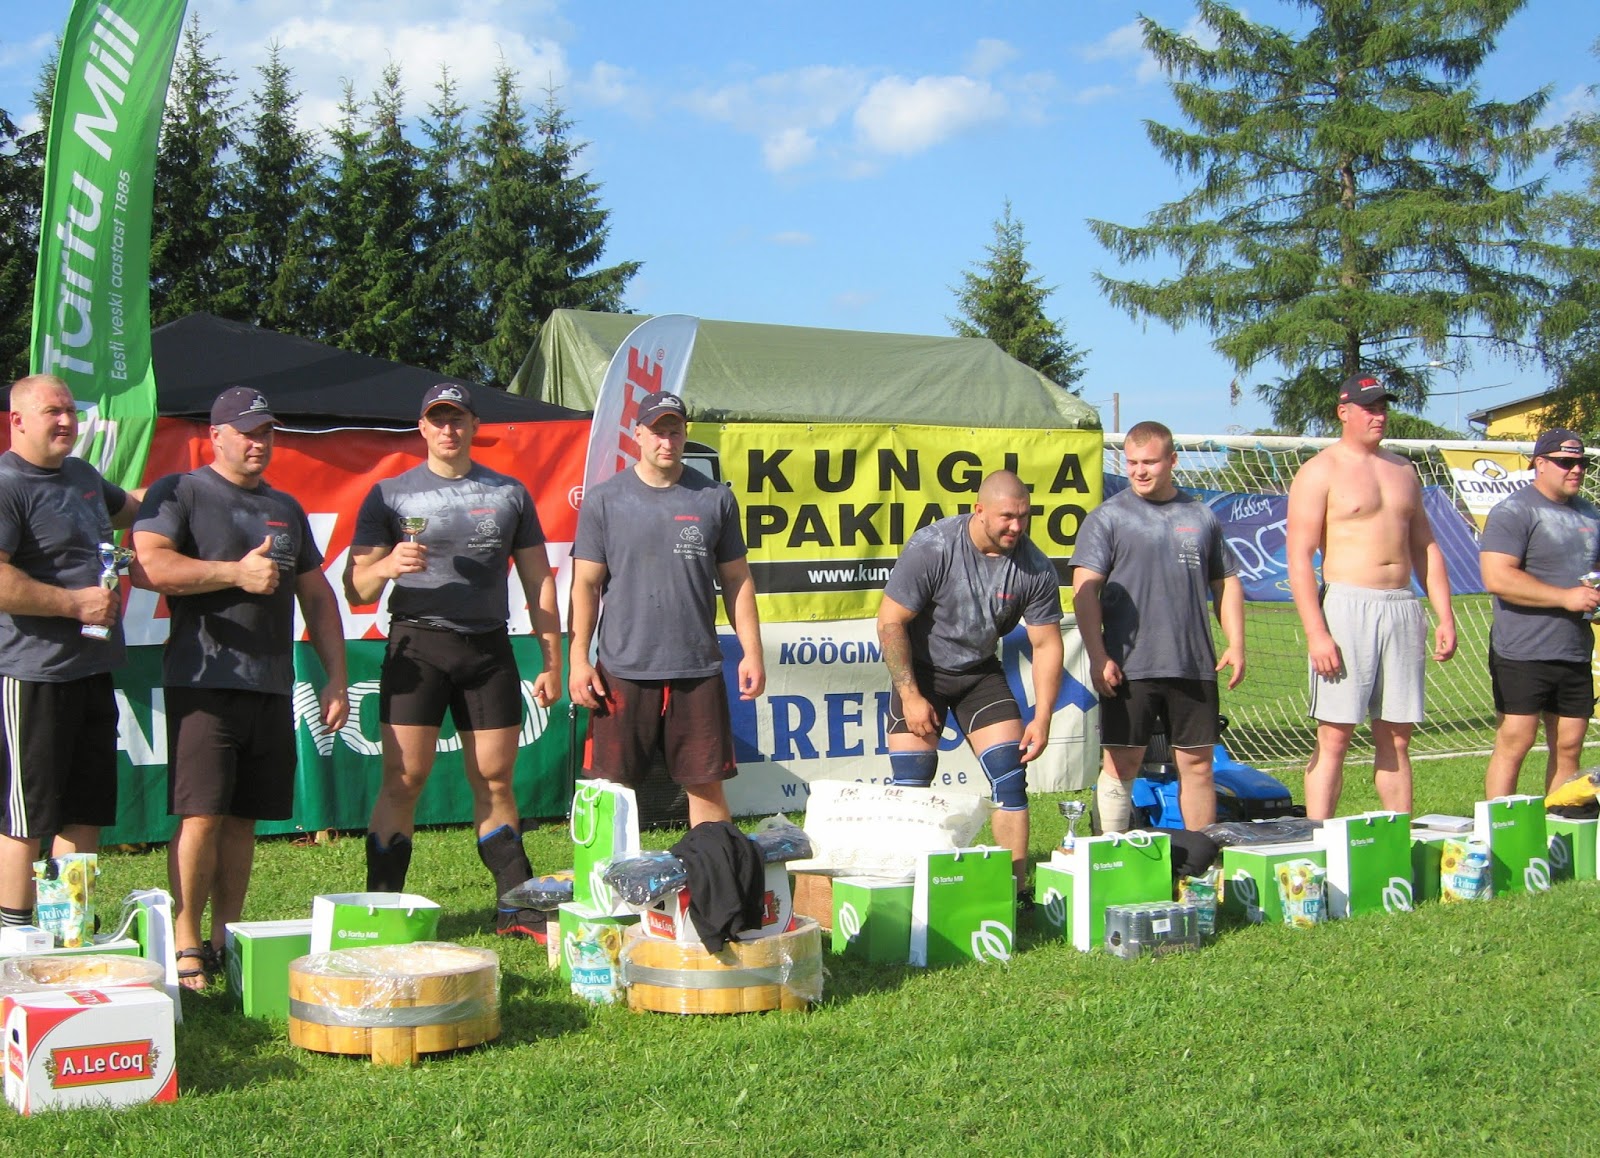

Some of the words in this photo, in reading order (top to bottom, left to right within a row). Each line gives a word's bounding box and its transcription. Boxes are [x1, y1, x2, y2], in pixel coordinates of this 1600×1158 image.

[43, 171, 104, 374] Tartu
[74, 3, 140, 161] Mill
[115, 170, 131, 212] 1885
[110, 218, 126, 288] aastast
[108, 291, 124, 335] veski
[109, 342, 127, 380] Eesti
[108, 1052, 143, 1072] Coq
